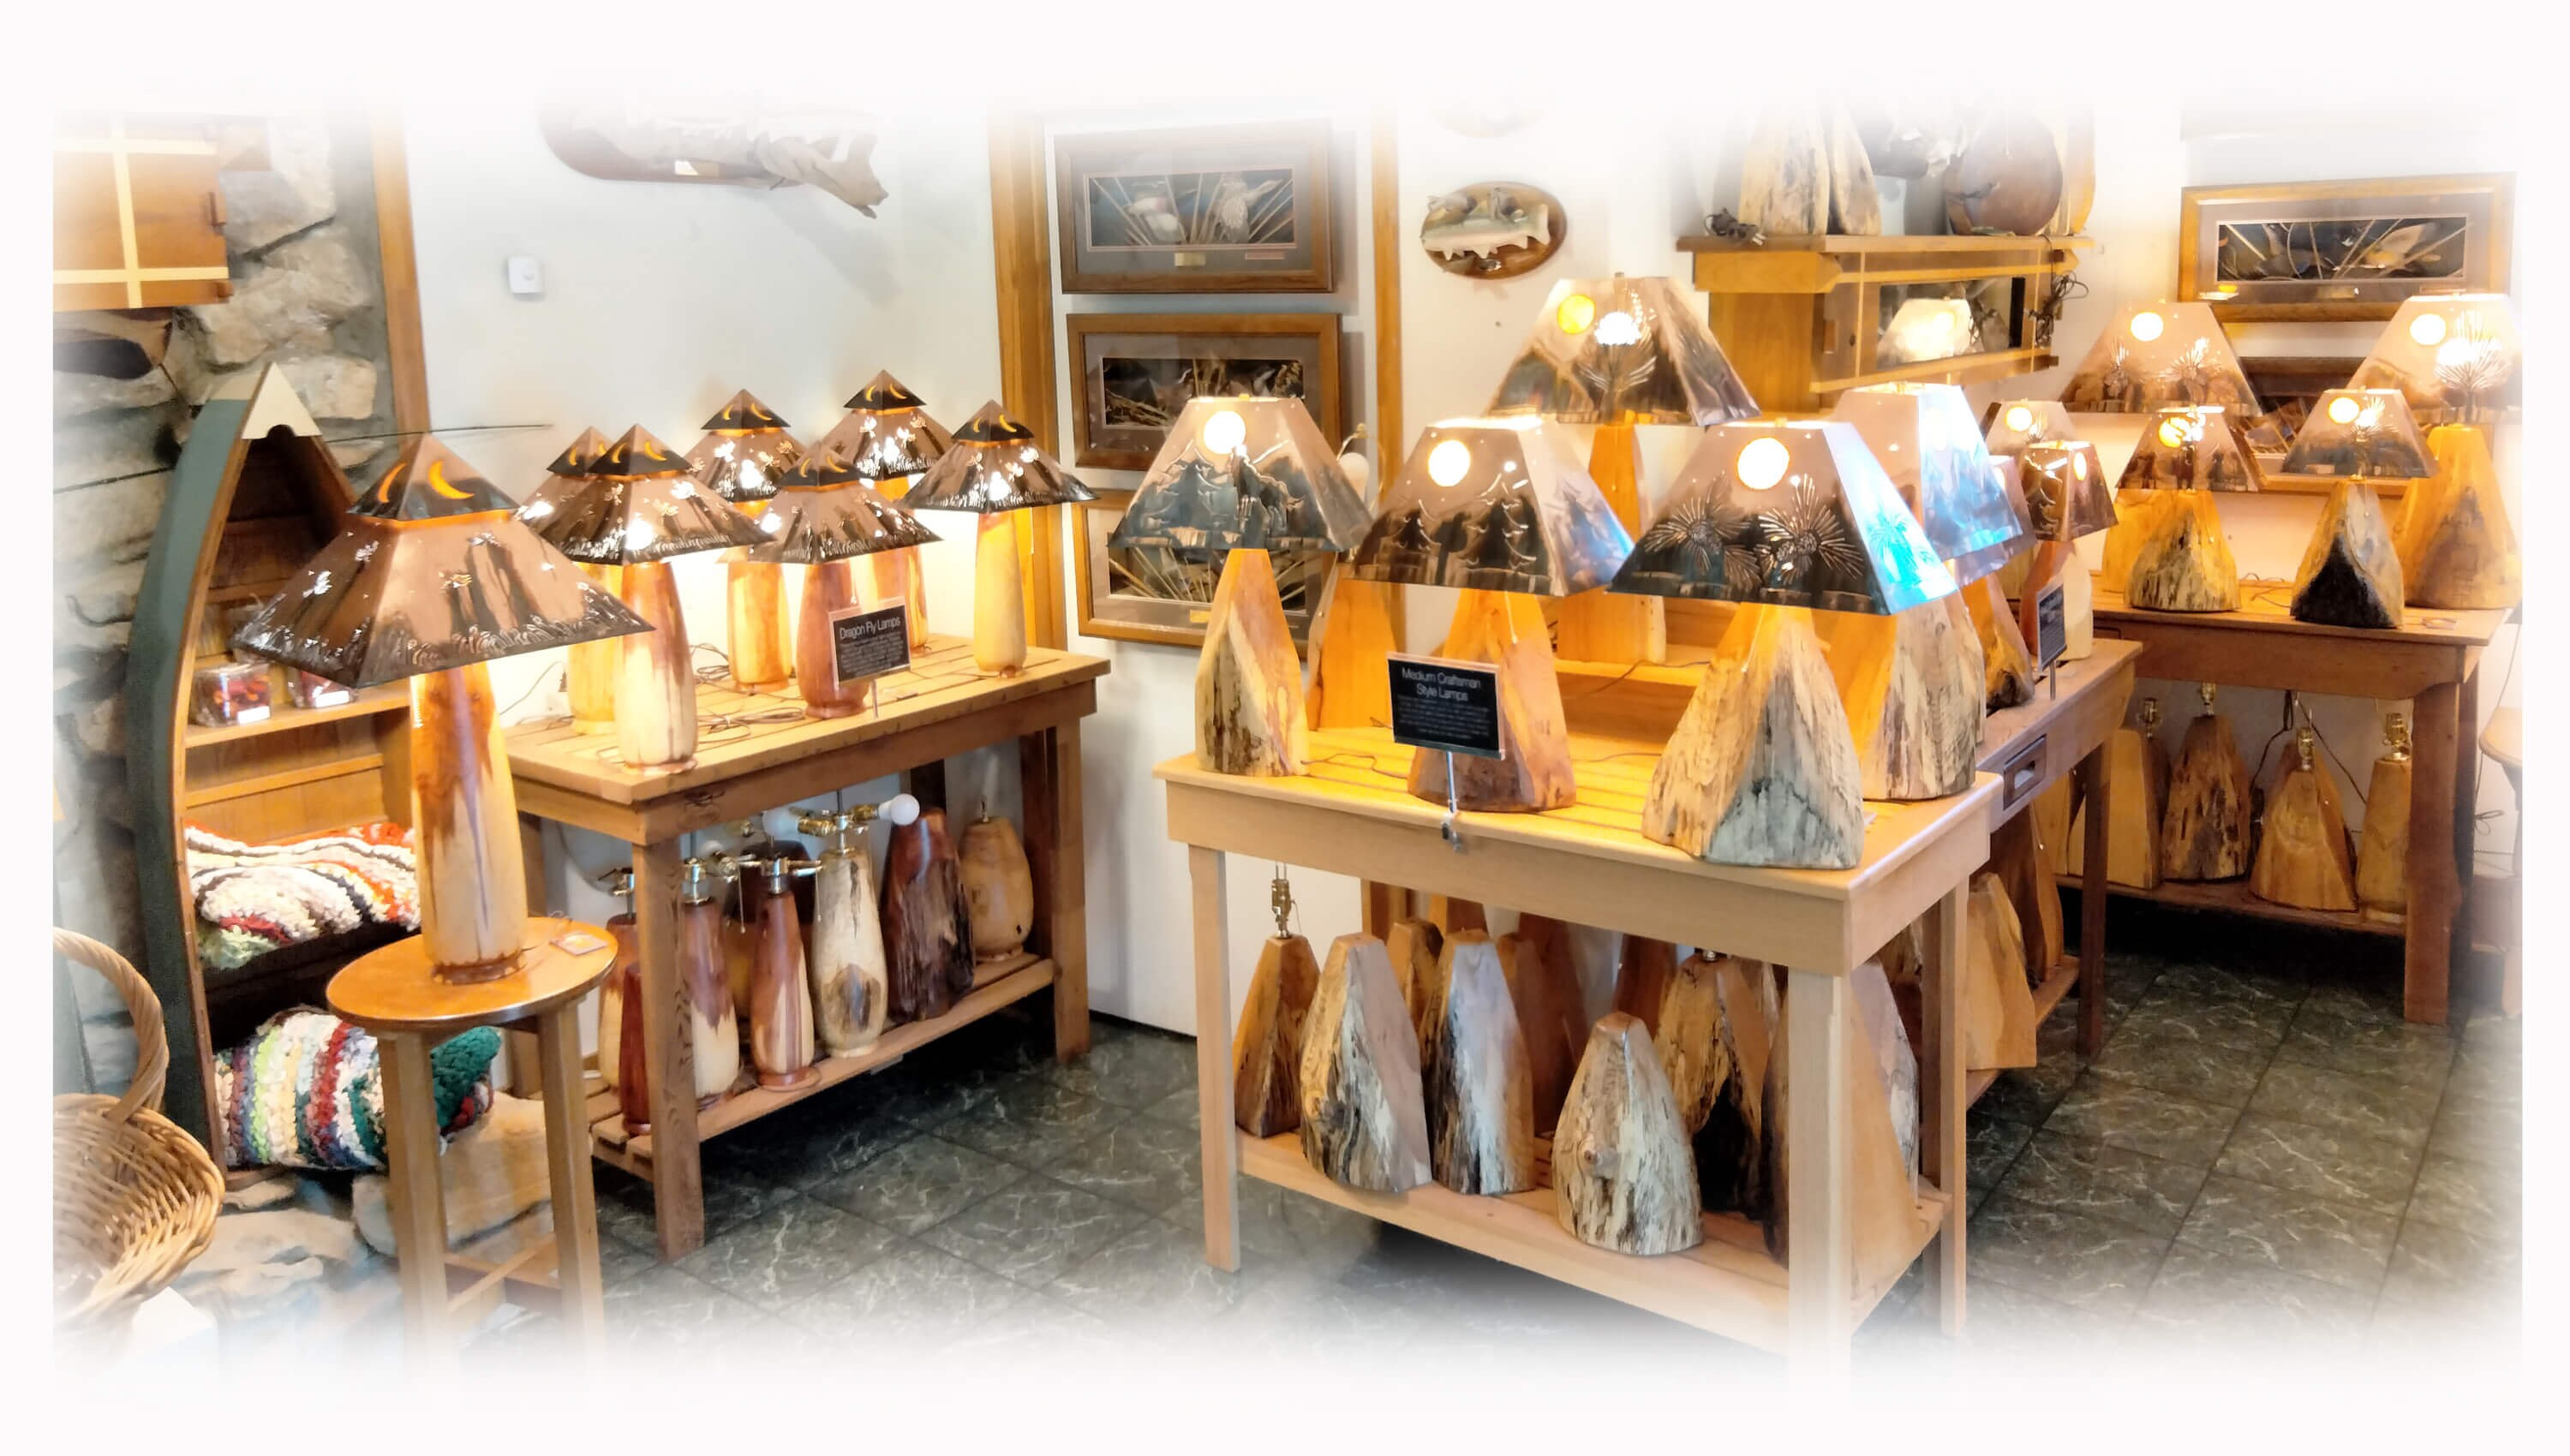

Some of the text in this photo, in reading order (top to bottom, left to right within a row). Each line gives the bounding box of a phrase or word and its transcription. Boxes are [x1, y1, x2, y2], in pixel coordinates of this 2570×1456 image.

[840, 617, 900, 640] Dragon Fly Lamps
[1402, 667, 1481, 689] Medium Craftsman
[1416, 683, 1467, 701] Style Lamps
